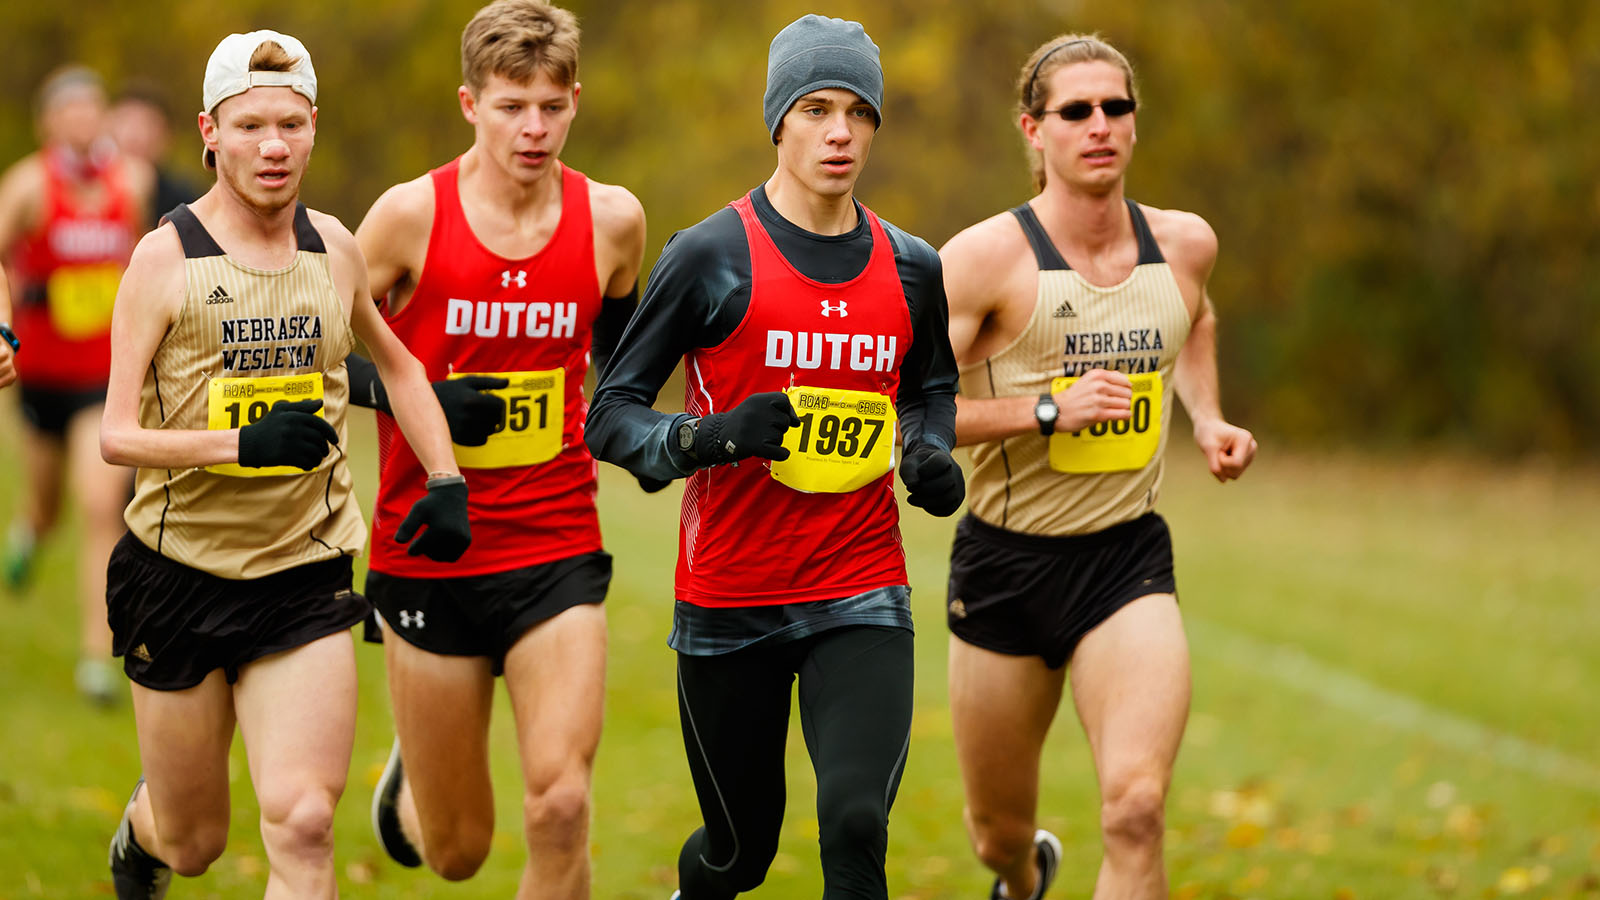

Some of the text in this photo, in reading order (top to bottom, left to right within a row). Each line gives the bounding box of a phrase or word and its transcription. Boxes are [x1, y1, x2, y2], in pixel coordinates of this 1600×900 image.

[206, 297, 234, 305] adidas
[222, 315, 322, 344] NEBRASKA
[445, 298, 577, 338] DUTCH
[765, 330, 897, 372] DUTCH
[1063, 328, 1163, 355] NEBRASKA
[221, 344, 317, 371] WESLEYAN
[225, 398, 313, 430] 19
[496, 393, 548, 432] 51
[799, 394, 887, 416] ROAD CROSS
[798, 412, 885, 459] 1937
